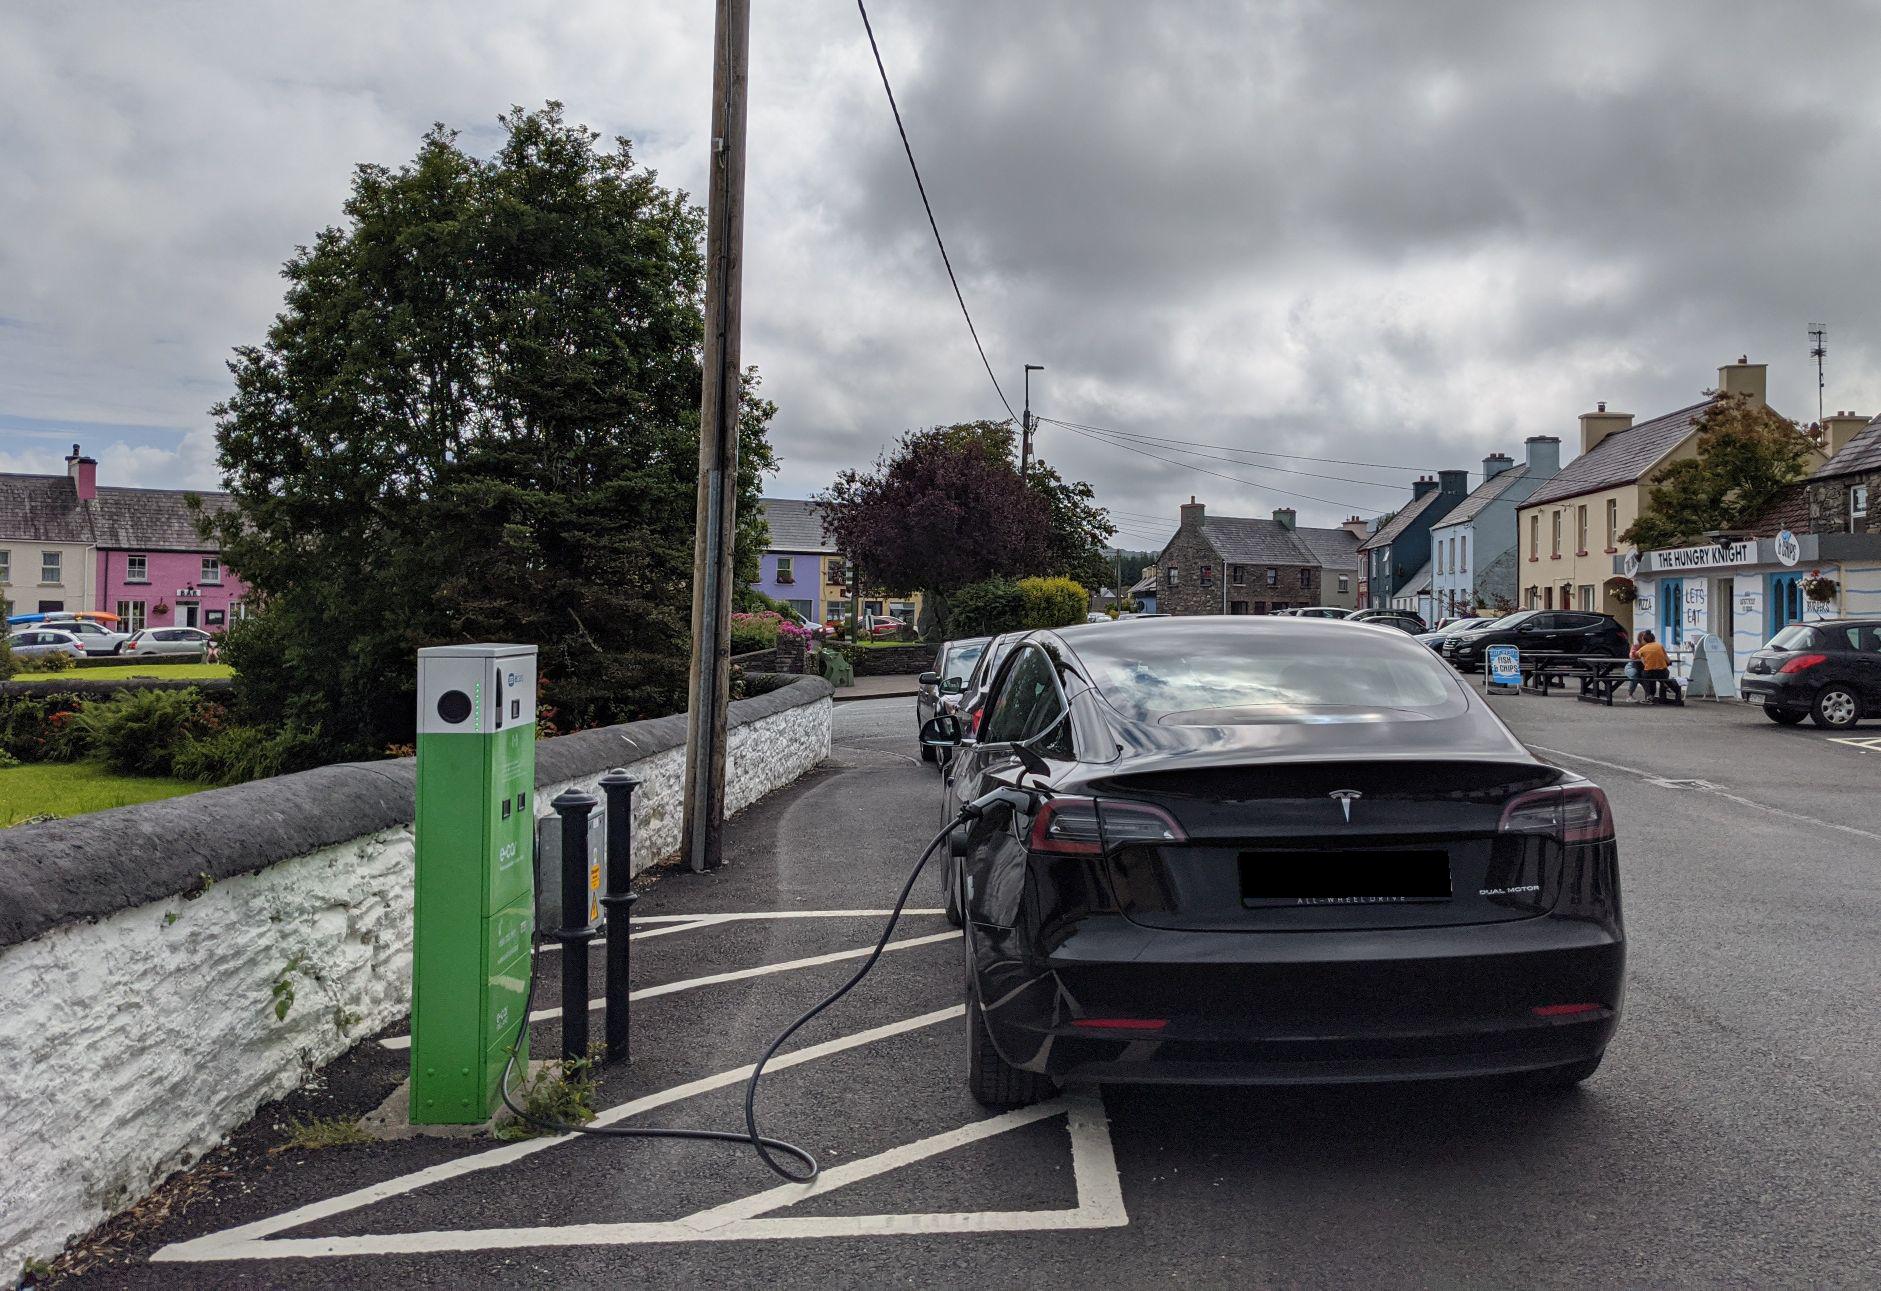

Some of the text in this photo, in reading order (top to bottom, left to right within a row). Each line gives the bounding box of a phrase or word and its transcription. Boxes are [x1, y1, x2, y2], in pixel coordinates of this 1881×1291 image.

[1658, 552, 1673, 568] THE
[1674, 547, 1711, 567] HUNGRY
[1712, 544, 1747, 564] KNIGHT
[1638, 598, 1652, 611] PIZZA
[1687, 608, 1703, 626] EAT
[1497, 656, 1512, 664] FISH
[1499, 664, 1518, 673] CHIPS
[1507, 885, 1540, 893] MOTOR
